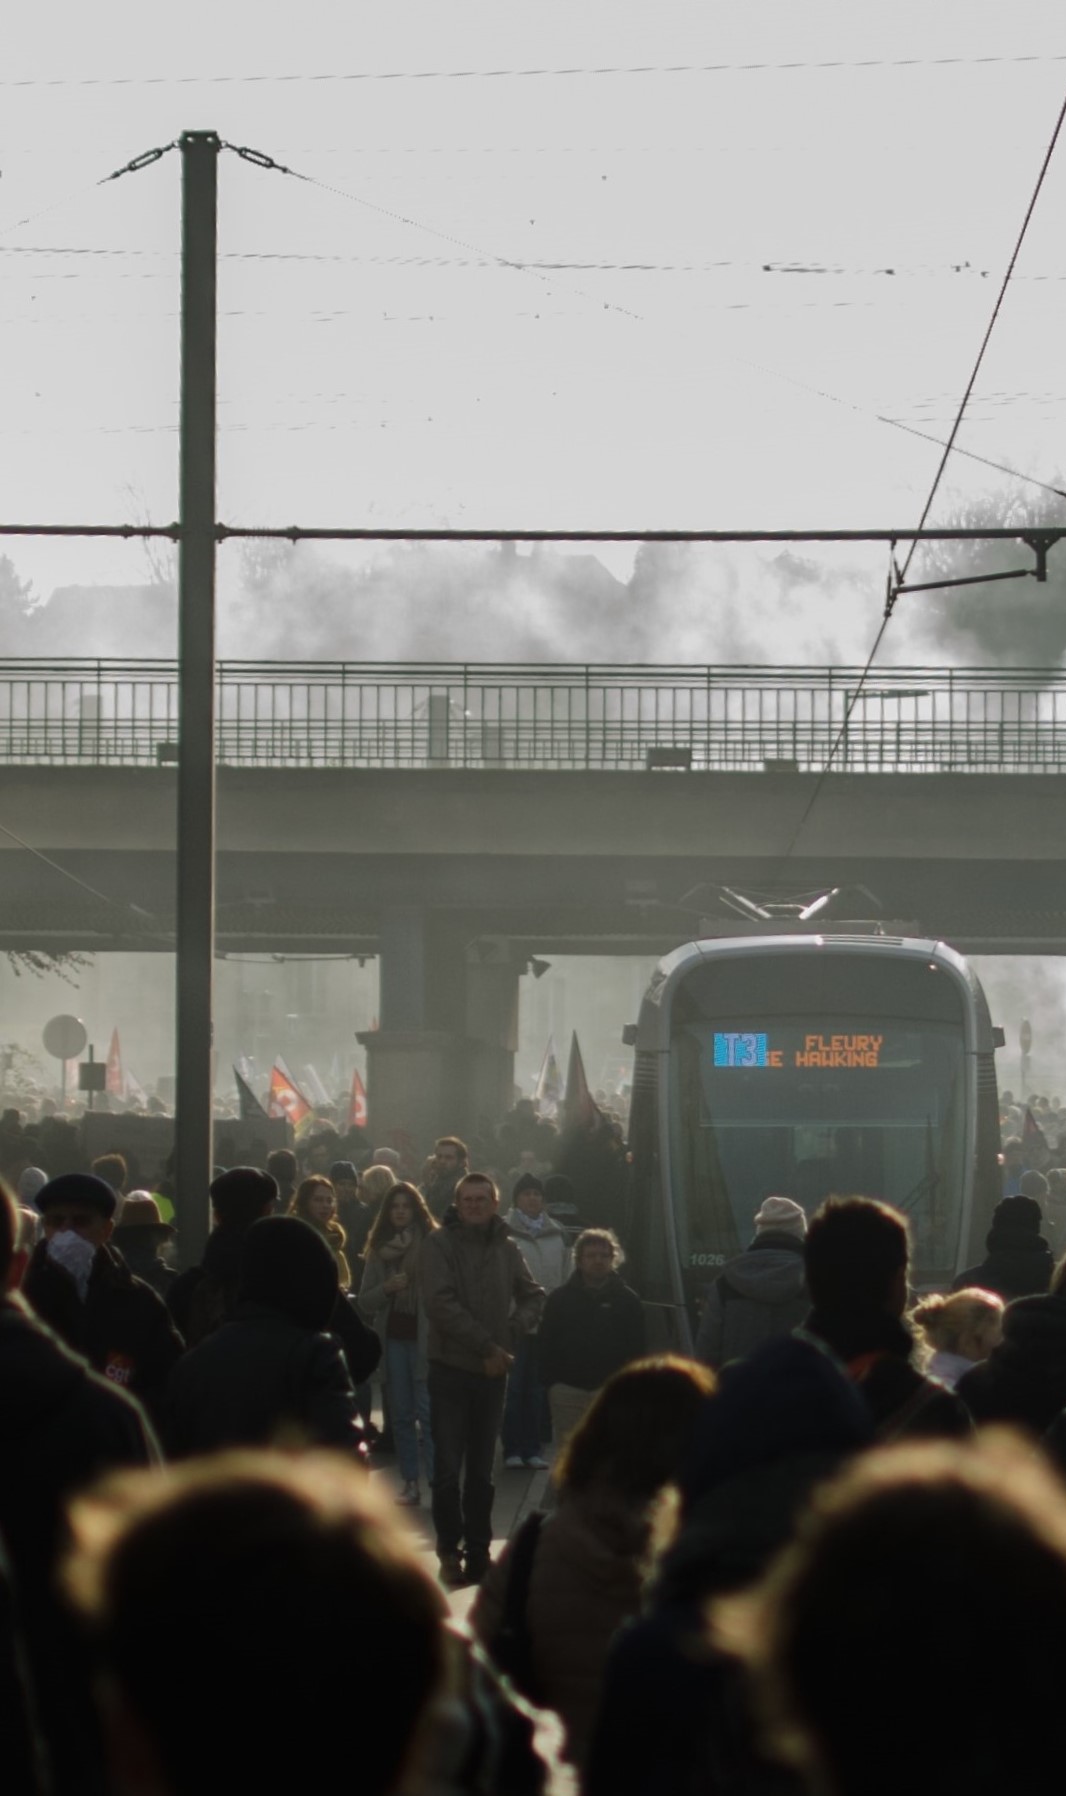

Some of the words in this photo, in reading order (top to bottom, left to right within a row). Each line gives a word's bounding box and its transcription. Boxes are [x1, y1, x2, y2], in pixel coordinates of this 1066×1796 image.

[724, 1033, 757, 1067] T3
[805, 1035, 883, 1051] FLEURY
[795, 1051, 878, 1067] HAWKING
[689, 1253, 724, 1266] 1026
